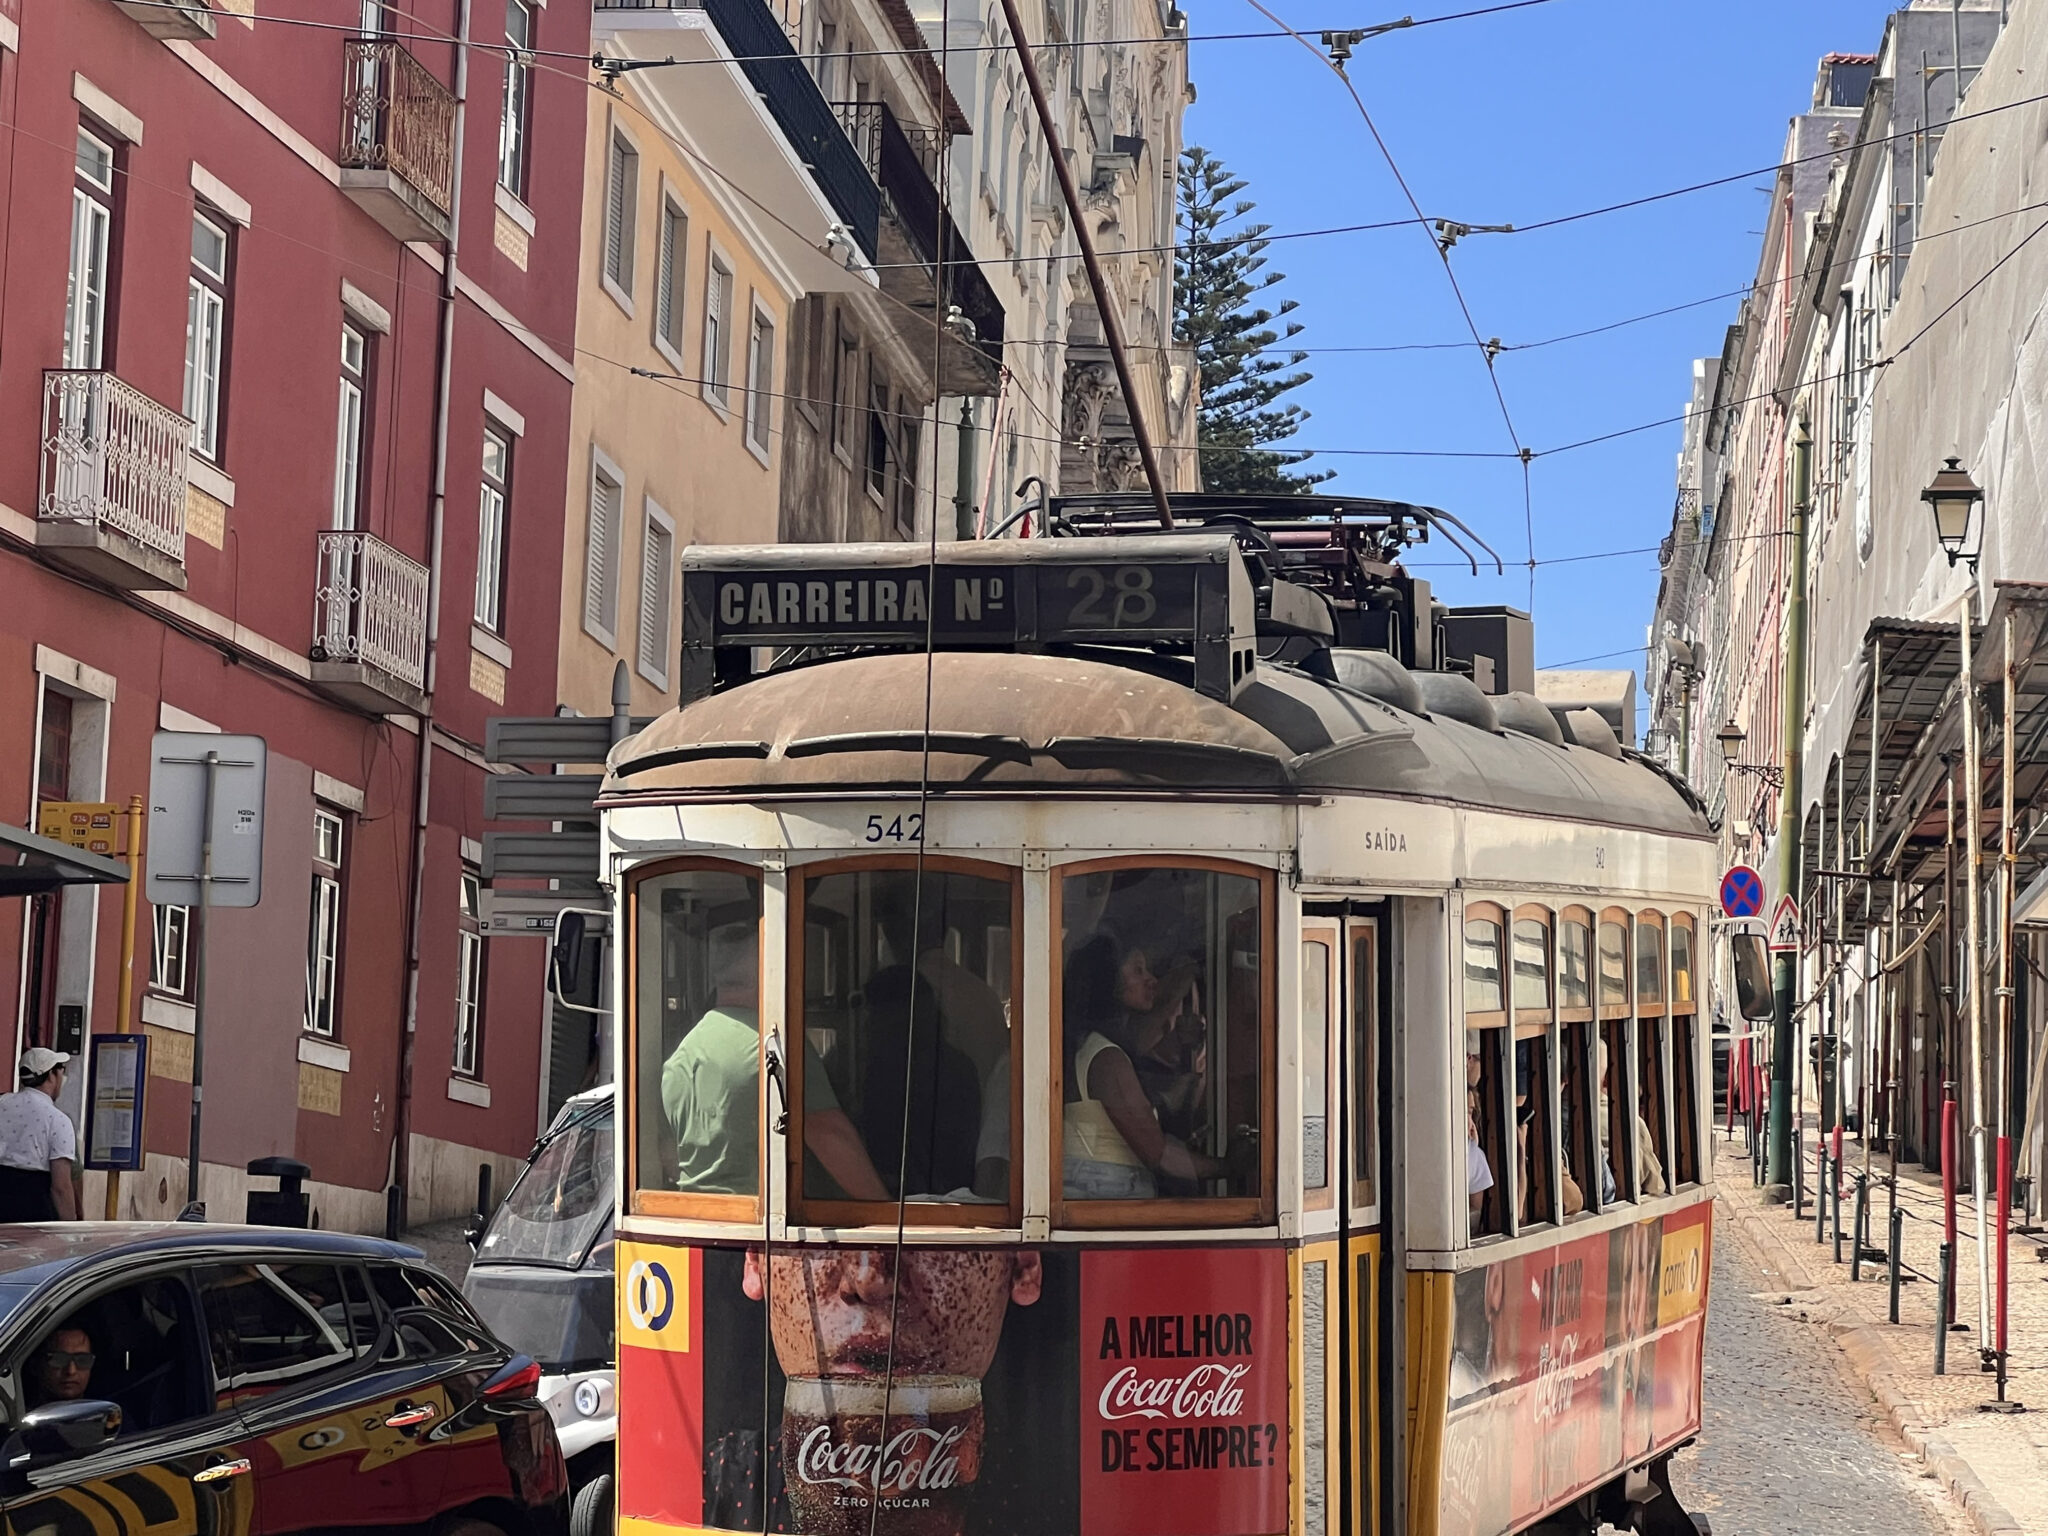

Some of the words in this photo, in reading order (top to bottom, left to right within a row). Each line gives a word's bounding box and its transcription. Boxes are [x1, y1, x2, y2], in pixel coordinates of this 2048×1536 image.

[719, 579, 928, 625] CARREIRA
[1066, 565, 1157, 624] 28
[865, 813, 925, 842] 542
[1365, 826, 1407, 852] SAÍDA
[1099, 1316, 1122, 1359] A
[1129, 1313, 1253, 1359] MELHOR
[1098, 1363, 1252, 1420] Coca-Cola
[797, 1424, 968, 1491] Coca-Cola
[1101, 1428, 1141, 1473] DE
[1145, 1423, 1278, 1472] SEMPRE?
[833, 1496, 869, 1508] ZERO
